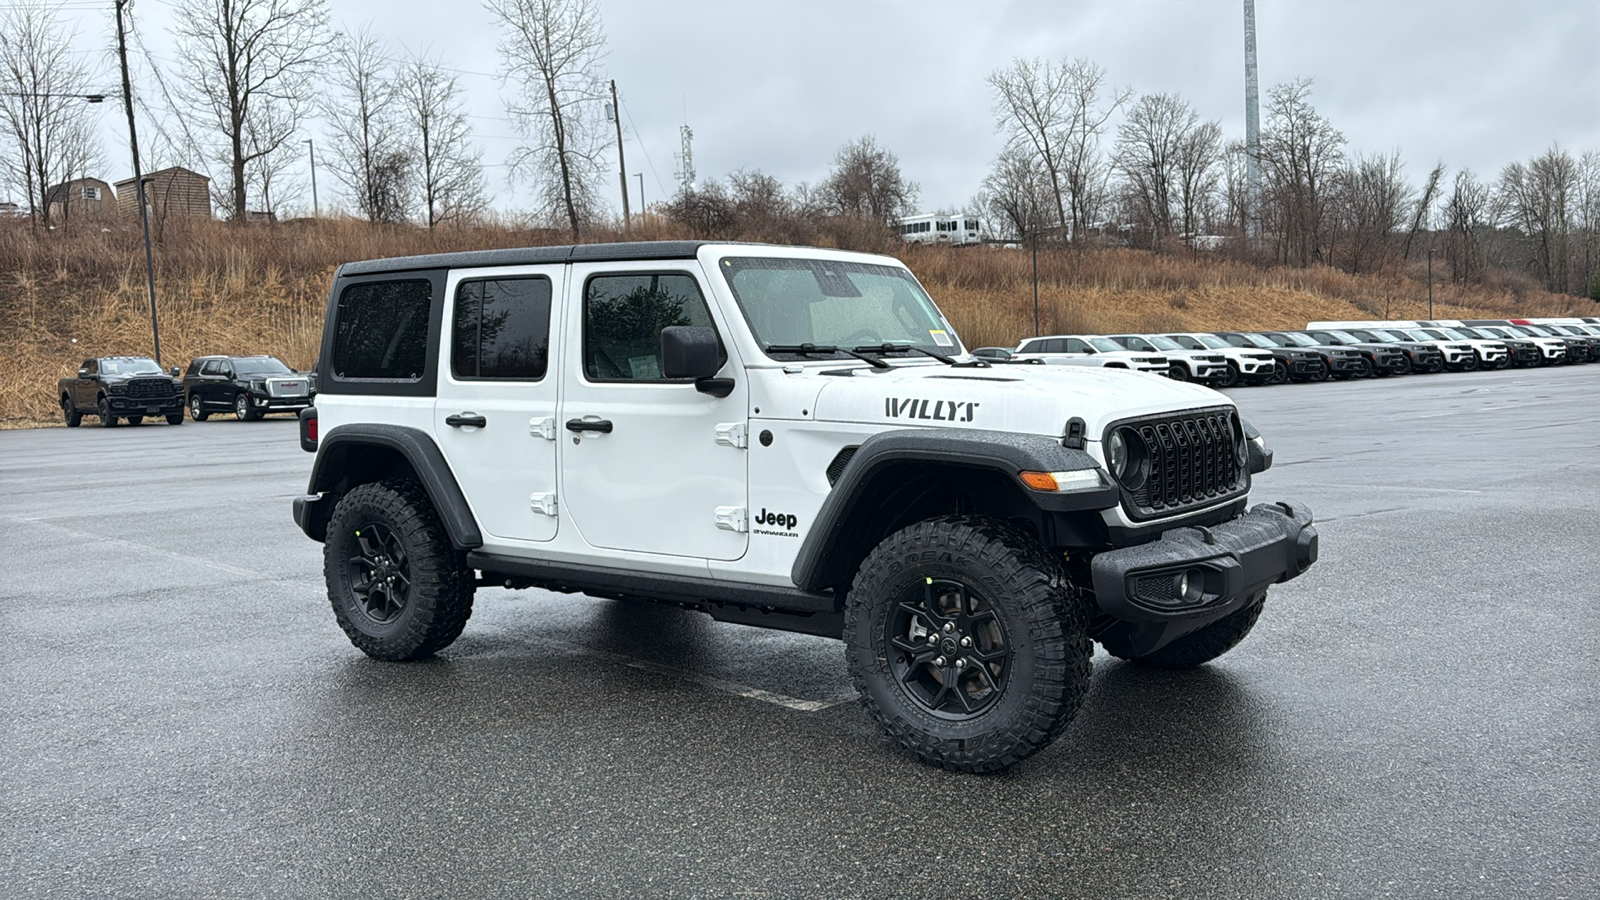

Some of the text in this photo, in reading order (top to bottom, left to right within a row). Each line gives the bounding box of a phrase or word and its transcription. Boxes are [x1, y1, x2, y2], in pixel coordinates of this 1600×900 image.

[885, 398, 980, 422] WILLYS
[755, 508, 797, 530] Jeep
[759, 530, 798, 538] WRANGLER
